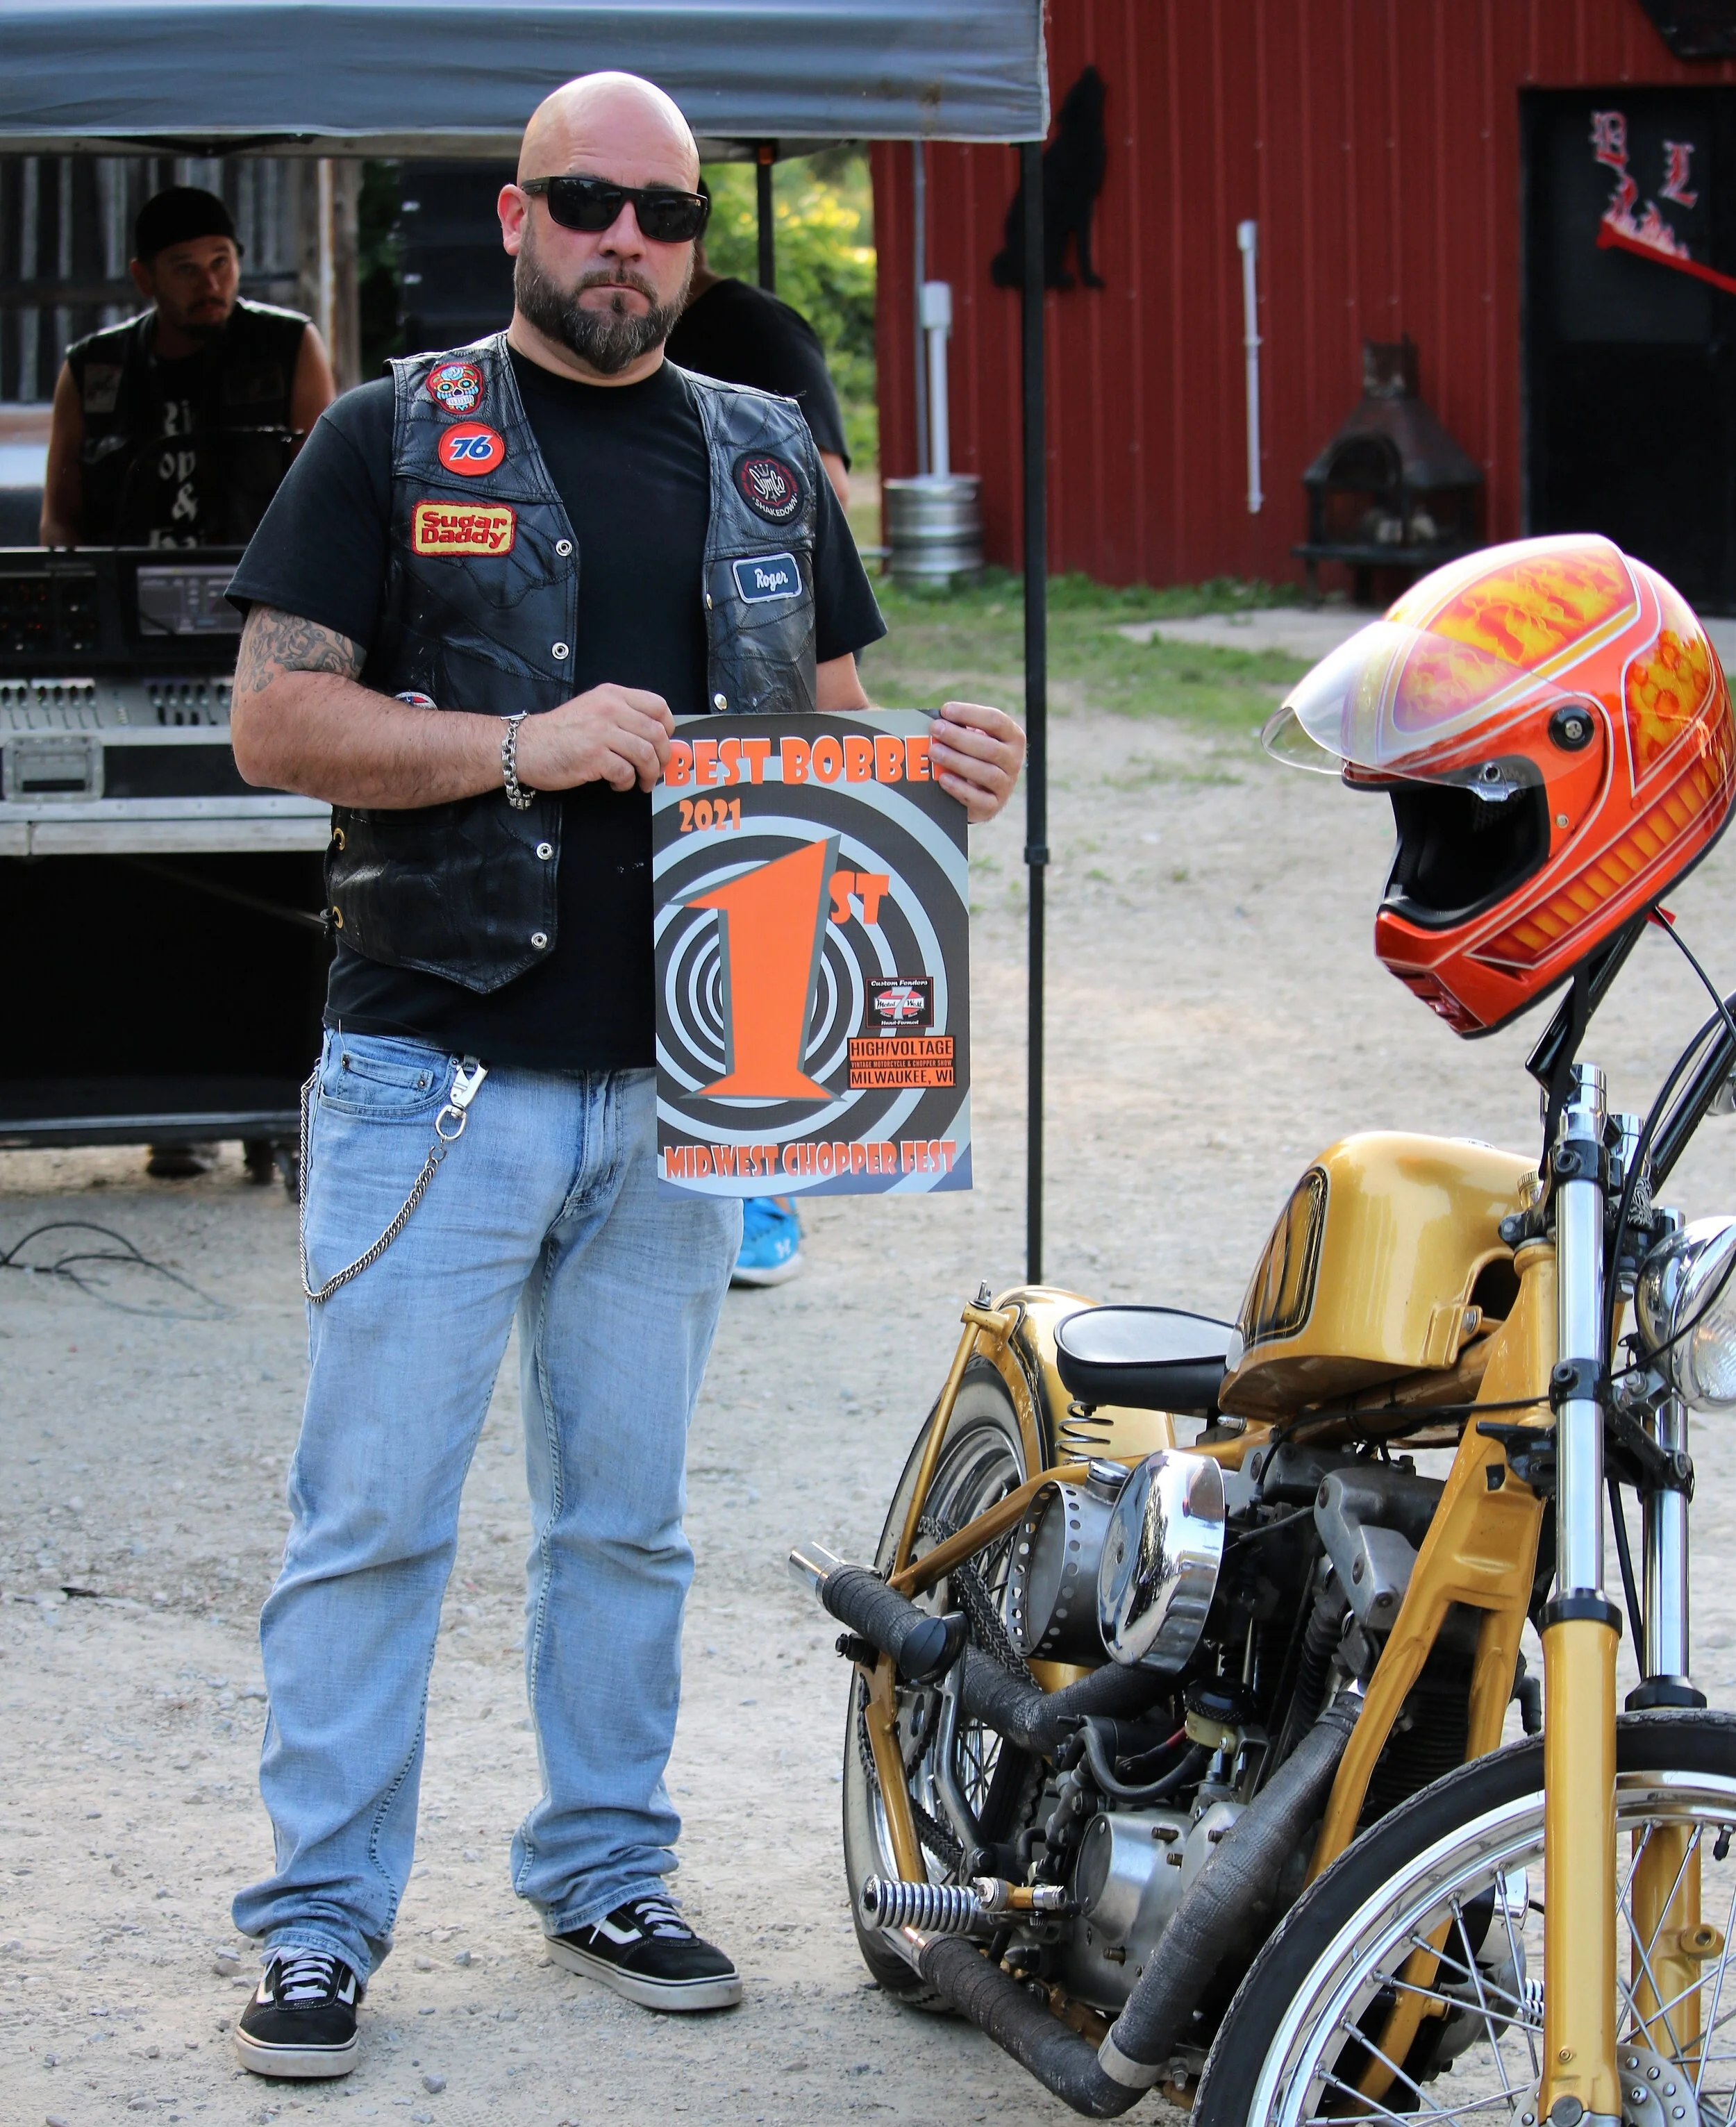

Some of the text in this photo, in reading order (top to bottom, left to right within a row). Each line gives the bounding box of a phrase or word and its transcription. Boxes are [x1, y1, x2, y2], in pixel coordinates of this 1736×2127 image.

[449, 435, 494, 461] 76
[755, 495, 798, 517] SHAKEDOWN
[422, 511, 508, 531] Sugar
[422, 528, 508, 549] Daddy
[754, 567, 788, 592] Roger
[663, 737, 771, 786] BEST
[679, 798, 741, 833] 2021
[851, 1069, 952, 1085] MILWAUKEE, WI
[663, 1139, 957, 1178] MIDWEST CHOPPER FEST
